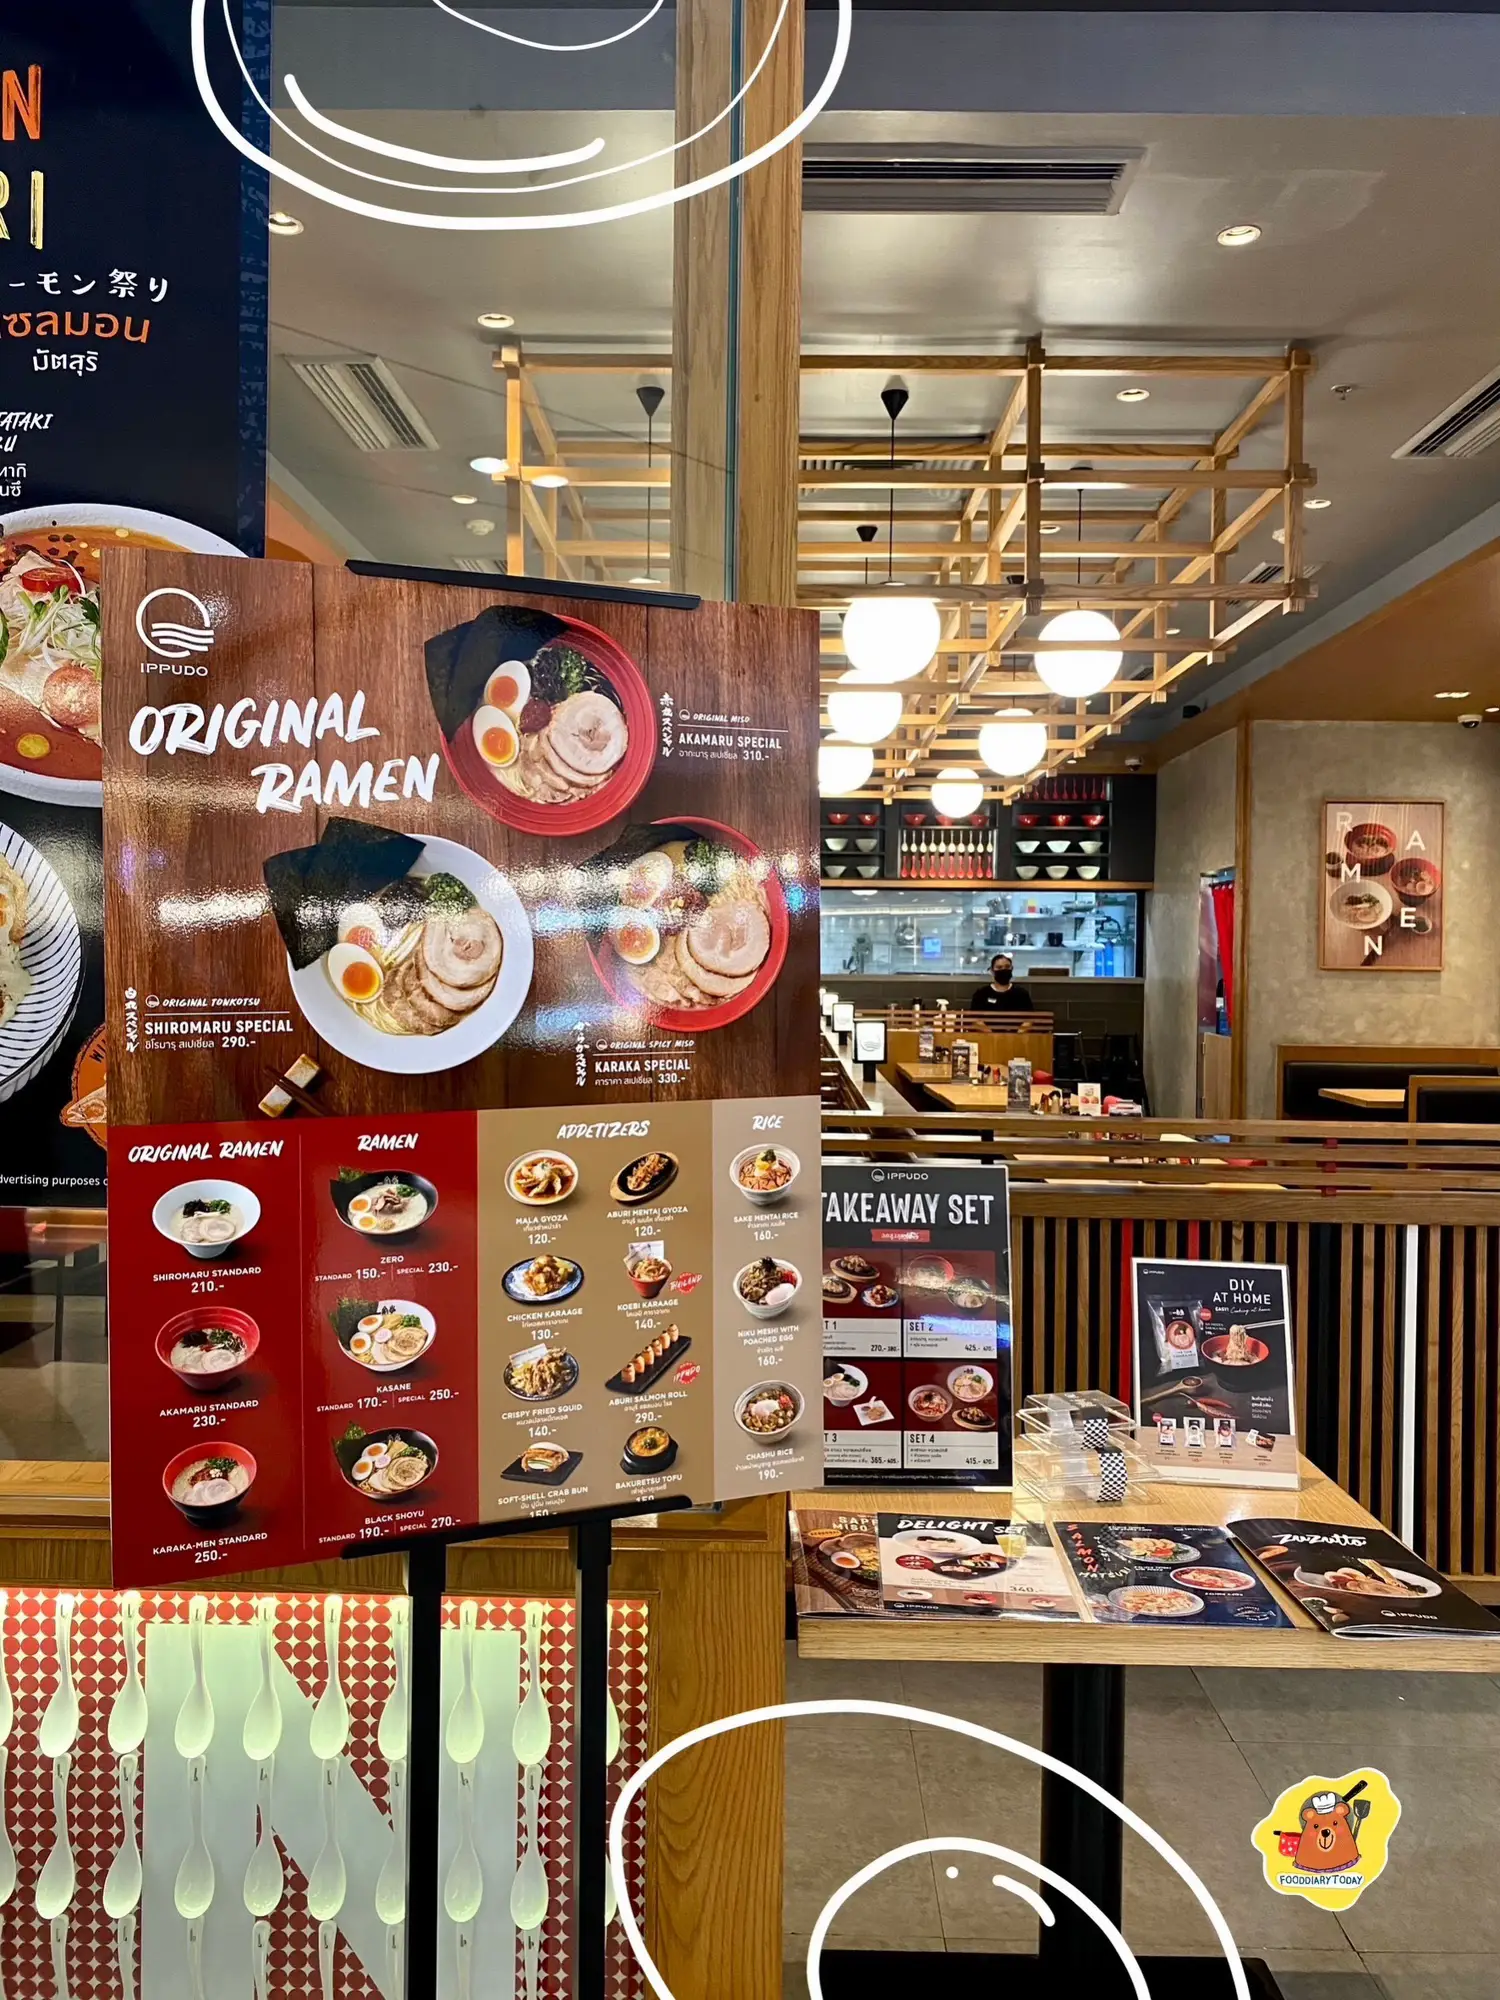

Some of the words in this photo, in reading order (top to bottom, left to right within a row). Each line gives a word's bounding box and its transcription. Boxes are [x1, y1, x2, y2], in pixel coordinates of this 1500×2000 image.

[33, 348, 98, 377] มัตสุริ
[140, 663, 208, 677] IPPUDO
[129, 690, 380, 756] ORIGINAL
[693, 713, 728, 723] ORIGINAL
[730, 714, 750, 723] MISO
[679, 732, 733, 747] AKAMARU
[737, 735, 782, 749] SPECIAL
[743, 750, 769, 760] 310.-
[251, 753, 440, 814] RAMEN
[162, 998, 208, 1008] ORIGINAL
[211, 998, 261, 1007] TONKOTSU
[144, 1021, 231, 1035] SHIROMARU
[235, 1020, 293, 1033] SPECIAL
[221, 1036, 256, 1048] 290.-
[610, 1041, 646, 1050] ORIGINAL
[649, 1040, 671, 1048] SPICY
[675, 1039, 695, 1047] MISO
[595, 1060, 641, 1073] KARAKA
[644, 1058, 691, 1071] SPECIAL
[658, 1072, 686, 1084] 330.-
[752, 1115, 784, 1130] RICE
[557, 1120, 650, 1139] APPETIZERS
[357, 1133, 419, 1151] RAMEN
[128, 1143, 213, 1163] ORIGINAL
[219, 1139, 284, 1159] RAMEN
[52, 1177, 100, 1187] purposes
[887, 1172, 929, 1180] IPPUDO
[607, 1210, 631, 1219] ABURI
[632, 1207, 660, 1217] MENTAI
[662, 1206, 688, 1214] GYOZA
[948, 1194, 994, 1225] SET
[515, 1217, 539, 1225] MALA
[541, 1214, 568, 1223] GYOZA
[733, 1215, 753, 1223] SAKE
[754, 1212, 780, 1221] MENTAI
[782, 1211, 799, 1219] RICE
[635, 1225, 661, 1237] 120.-
[754, 1230, 779, 1241] 160.-
[528, 1233, 556, 1244] 120.-
[380, 1255, 404, 1264] ZERO
[153, 1270, 210, 1282] SHIROMARU
[212, 1266, 262, 1278] STANDARD
[315, 1273, 352, 1282] STANDARD
[356, 1268, 386, 1280] 150.-
[396, 1266, 425, 1275] SPECIAL
[428, 1261, 459, 1274] 230.-
[191, 1281, 225, 1293] 210.-
[1229, 1279, 1255, 1292] DIY
[1213, 1291, 1228, 1303] AT
[1233, 1293, 1271, 1305] HOME
[617, 1303, 641, 1311] KOEBI
[642, 1299, 679, 1308] KARAAGE
[507, 1312, 543, 1322] CHICKEN
[544, 1308, 583, 1318] KARAAGE
[635, 1318, 661, 1330] 140.-
[909, 1322, 925, 1331] SET
[928, 1323, 934, 1331] 2
[531, 1329, 560, 1341] 130.-
[737, 1329, 755, 1338] NIKU
[757, 1327, 778, 1336] MESHI
[780, 1325, 799, 1333] WITH
[743, 1336, 777, 1345] POACHED
[779, 1334, 794, 1342] EGG
[870, 1344, 886, 1352] 270.-
[964, 1343, 980, 1351] 425.-
[758, 1355, 782, 1366] 160.-
[376, 1383, 411, 1393] KASANE
[316, 1402, 354, 1412] STANDARD
[357, 1396, 388, 1410] 170.-
[398, 1394, 425, 1403] SPECIAL
[429, 1388, 460, 1401] 250.-
[609, 1398, 633, 1406] ABURI
[634, 1394, 666, 1403] SALMON
[159, 1405, 207, 1417] AKAMARU
[209, 1400, 259, 1412] STANDARD
[501, 1410, 530, 1420] CRISPY
[532, 1407, 556, 1416] FRIED
[558, 1403, 583, 1412] SQUID
[193, 1415, 226, 1428] 230.-
[635, 1411, 662, 1424] 290.-
[529, 1425, 557, 1438] 140.-
[910, 1434, 926, 1443] SET
[929, 1434, 935, 1443] 4
[746, 1450, 775, 1460] CHASHU
[777, 1448, 793, 1456] RICE
[965, 1457, 981, 1465] 415.-
[758, 1468, 784, 1480] 190.-
[615, 1477, 661, 1490] BAKURETSU
[662, 1474, 682, 1482] TOFU
[498, 1492, 546, 1505] SOFT-SHELL
[548, 1489, 569, 1498] CRAB
[571, 1486, 588, 1495] BUN
[365, 1513, 393, 1525] BLACK
[395, 1510, 425, 1521] SHOYU
[318, 1533, 356, 1544] STANDARD
[359, 1526, 390, 1539] 190.-
[400, 1523, 427, 1532] SPECIAL
[431, 1516, 461, 1529] 270.-
[832, 1522, 868, 1532] MISO
[897, 1519, 993, 1532] DELIGHT
[993, 1526, 1027, 1535] SET
[152, 1539, 216, 1555] KARAKA-MEN
[218, 1532, 268, 1546] STANDARD
[194, 1549, 228, 1564] 250.-
[1397, 1612, 1438, 1620] IPPUDO
